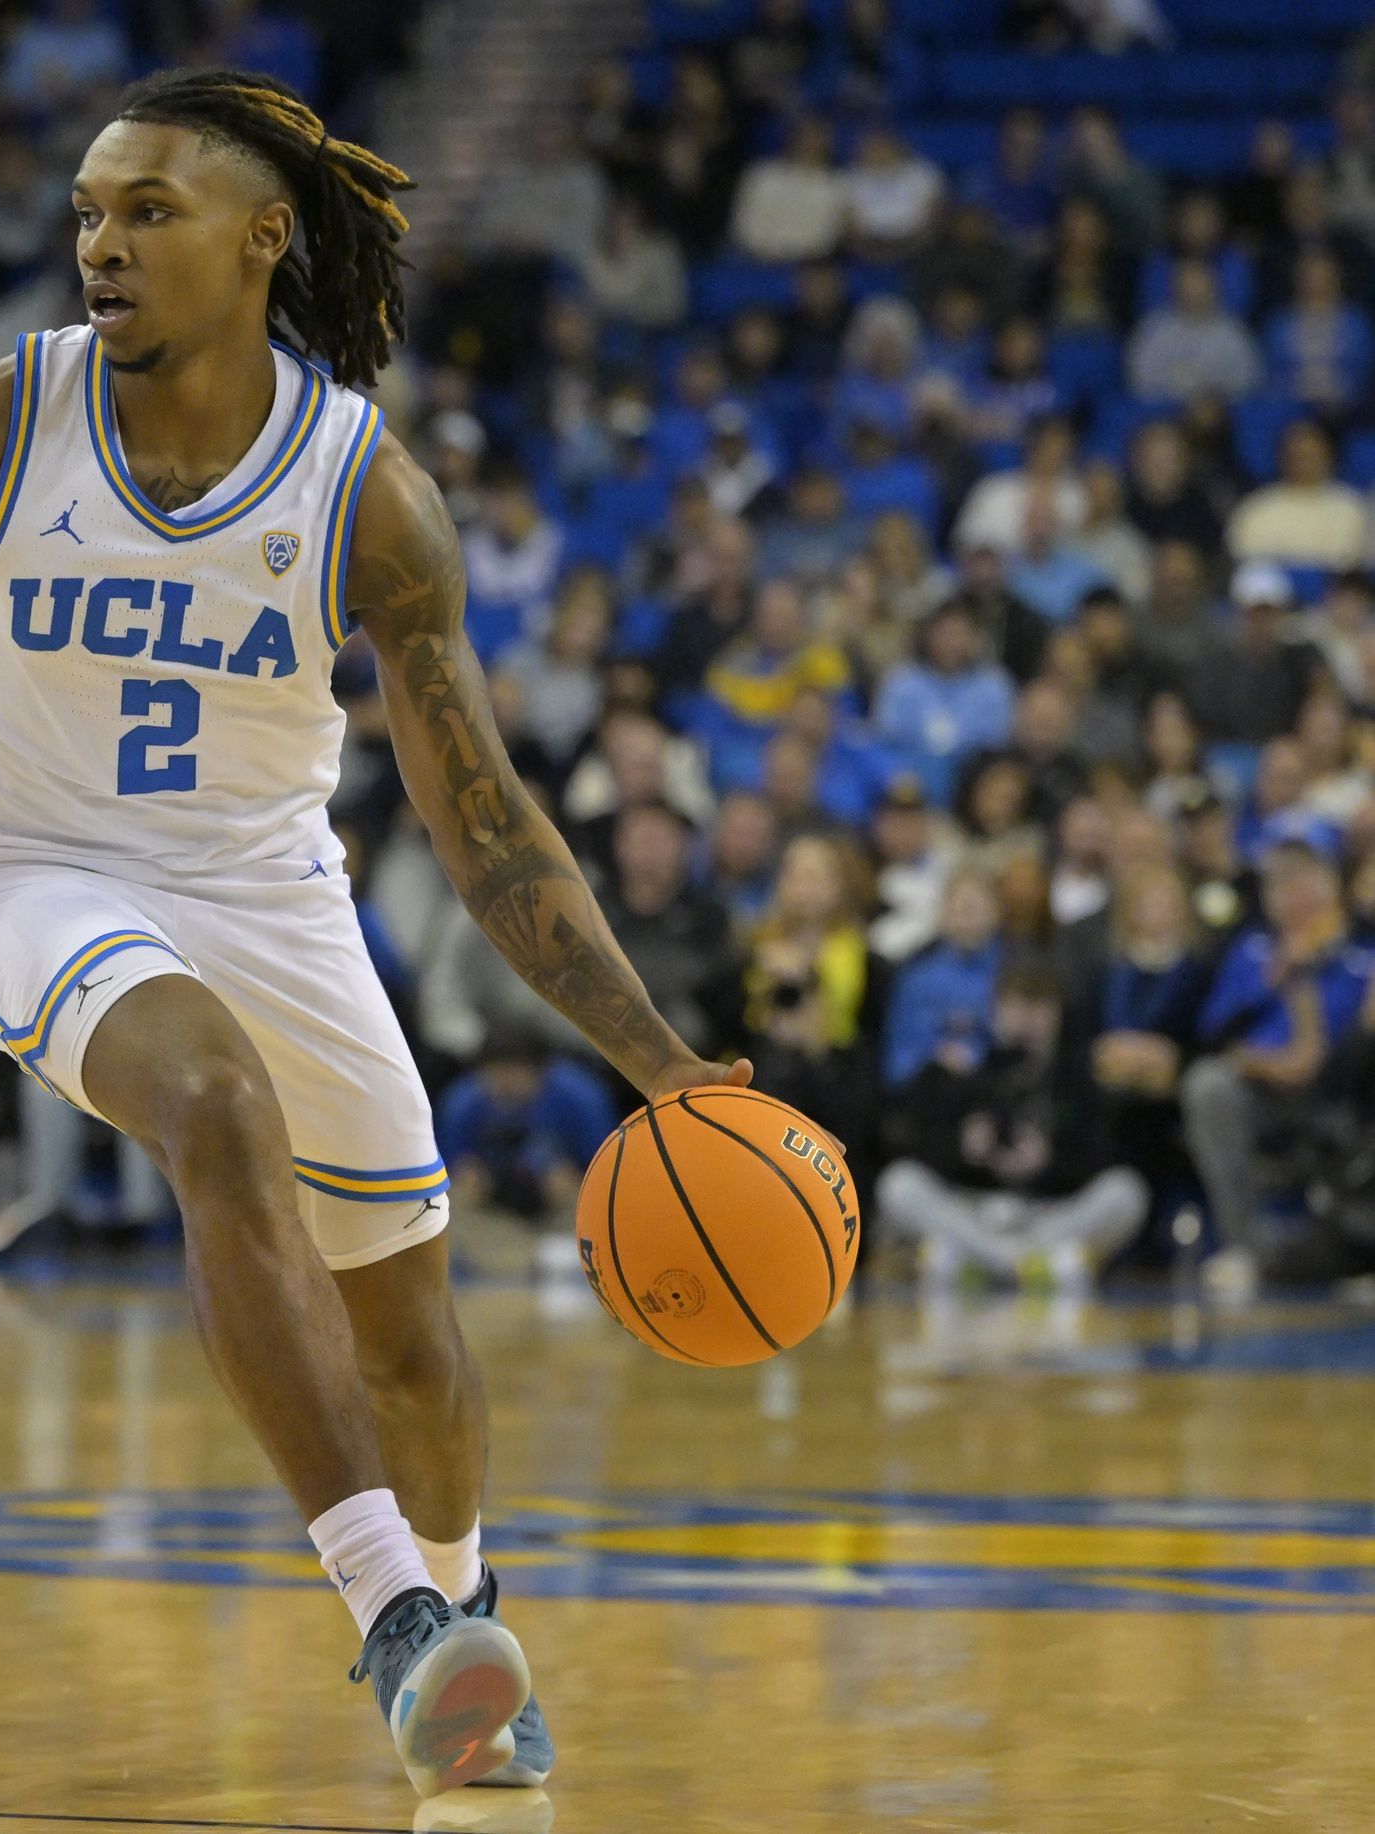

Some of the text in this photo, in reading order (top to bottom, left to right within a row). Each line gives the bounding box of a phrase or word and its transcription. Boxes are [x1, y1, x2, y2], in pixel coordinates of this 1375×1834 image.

[270, 551, 288, 568] 12
[9, 577, 300, 679] UCLA
[117, 678, 201, 796] 2
[781, 1126, 857, 1258] UCLA
